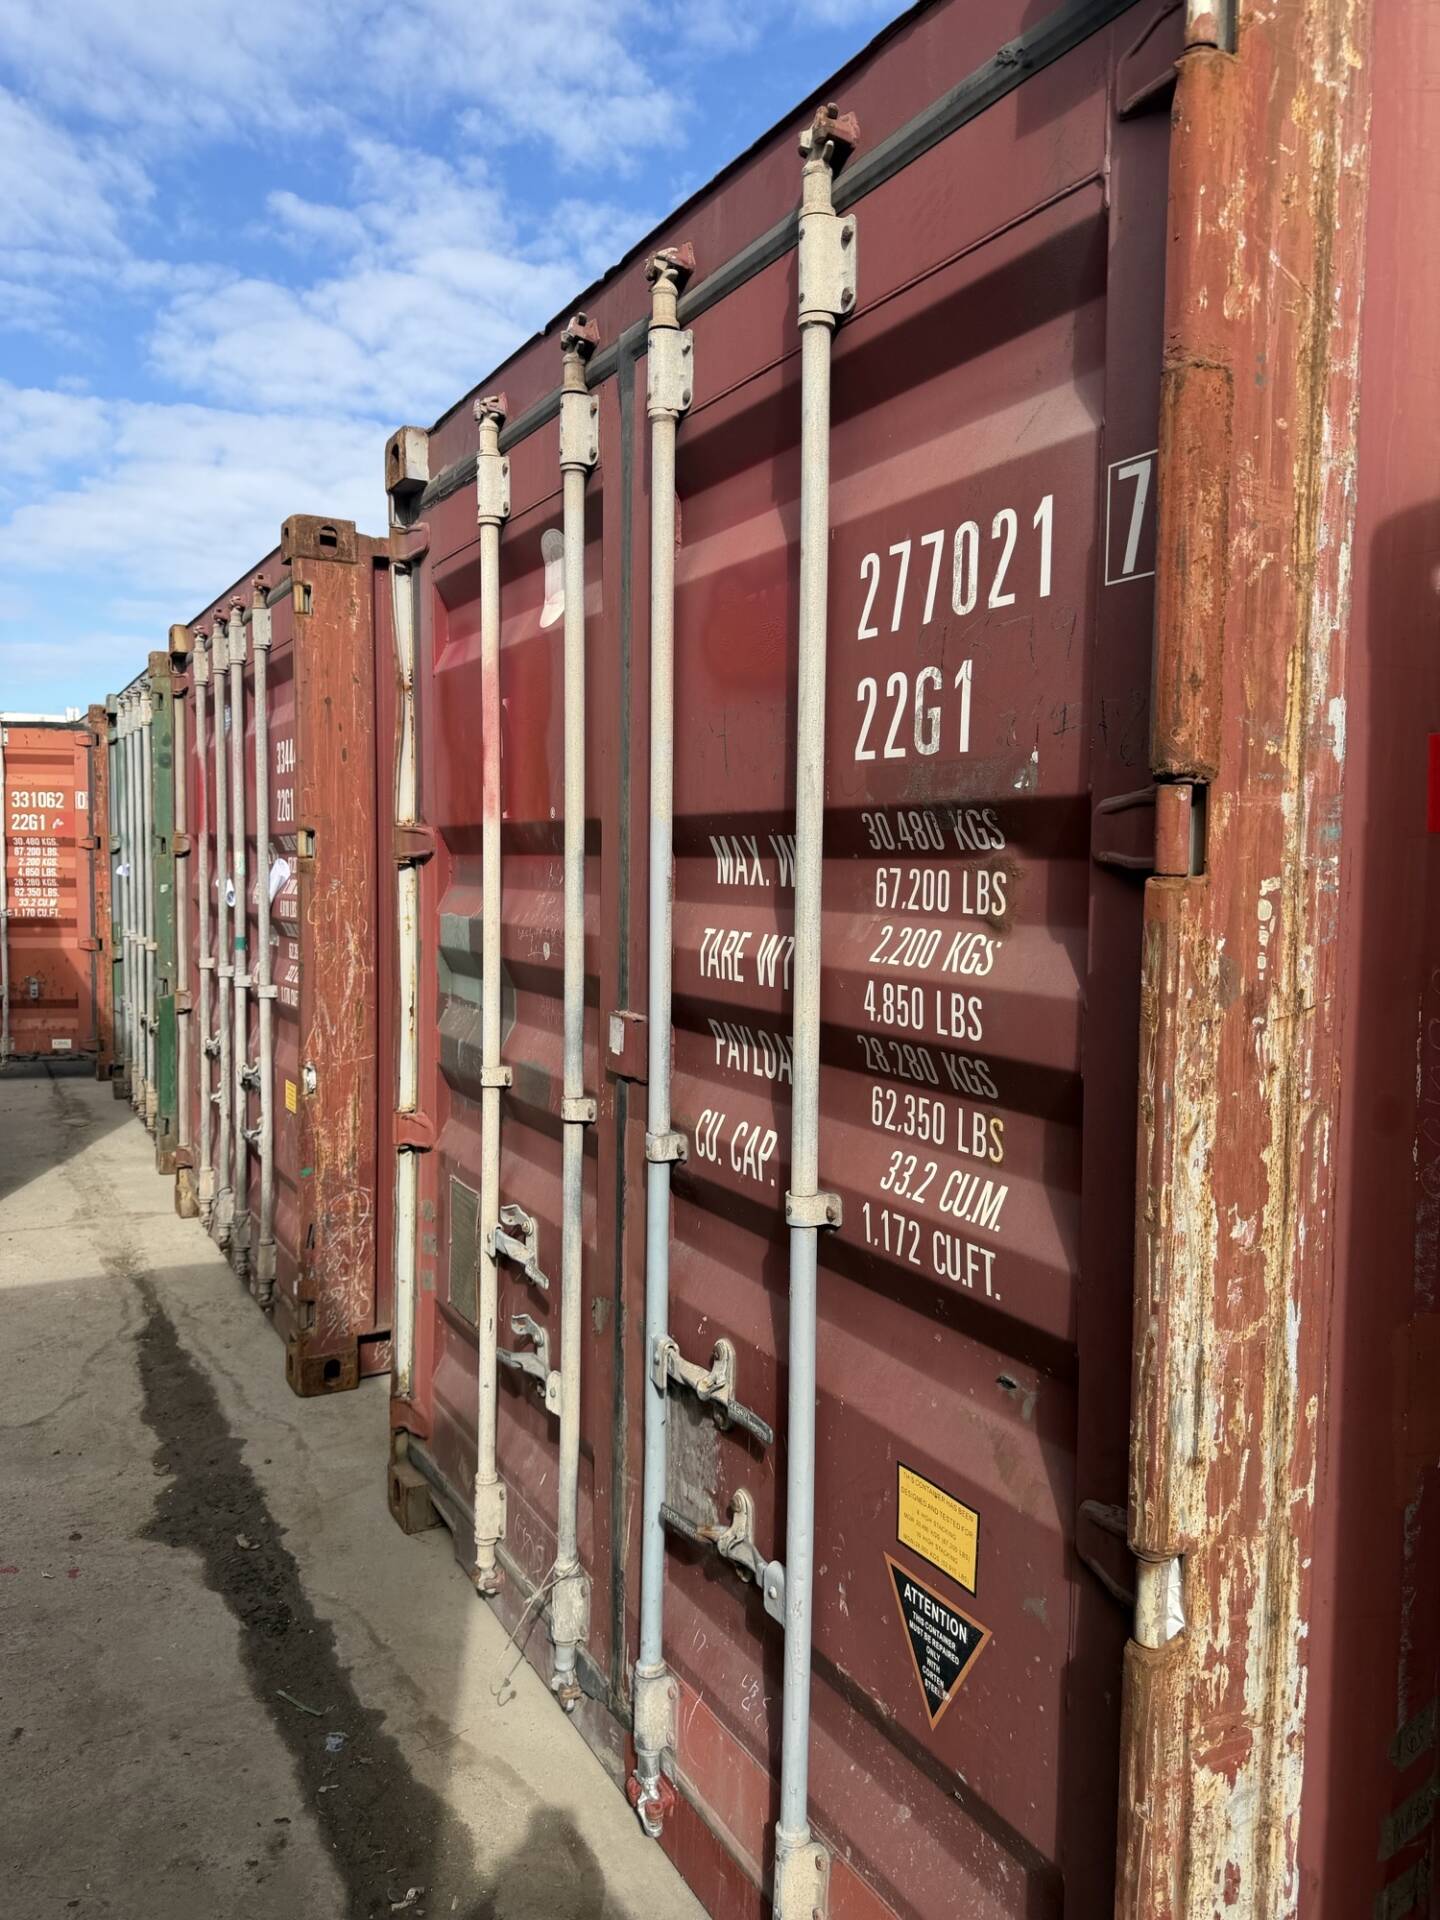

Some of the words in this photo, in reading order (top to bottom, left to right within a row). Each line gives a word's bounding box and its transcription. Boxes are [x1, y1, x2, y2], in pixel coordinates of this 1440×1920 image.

[1118, 459, 1152, 574] 7
[857, 494, 1053, 640] 277021
[855, 660, 973, 760] 22G1
[11, 791, 64, 808] 331062
[11, 814, 46, 831] 22G1
[277, 788, 294, 822] 22G1
[950, 808, 1006, 850] KGS
[709, 835, 770, 887] MAX.
[962, 870, 1007, 916] LBS
[699, 928, 752, 983] TARE
[942, 931, 1002, 976] KGS
[936, 990, 983, 1042] LBS
[708, 1018, 794, 1085] PAYLOA
[941, 1052, 999, 1099] KGS
[695, 1108, 726, 1165] CU.
[730, 1121, 778, 1187] CAP.
[957, 1107, 1004, 1163] LBS
[879, 1150, 938, 1203] 33.2
[940, 1510, 960, 1531] TESTED
[904, 1583, 967, 1644] ATTENTION
[912, 1611, 925, 1626] THIS
[924, 1621, 956, 1652] CONTAINER
[909, 1620, 924, 1638] MUST
[924, 1631, 932, 1644] BE
[932, 1636, 960, 1666] REPAIRED
[926, 1646, 940, 1662] ONLY
[926, 1656, 940, 1674] WITH
[922, 1664, 944, 1689] CORTEN
